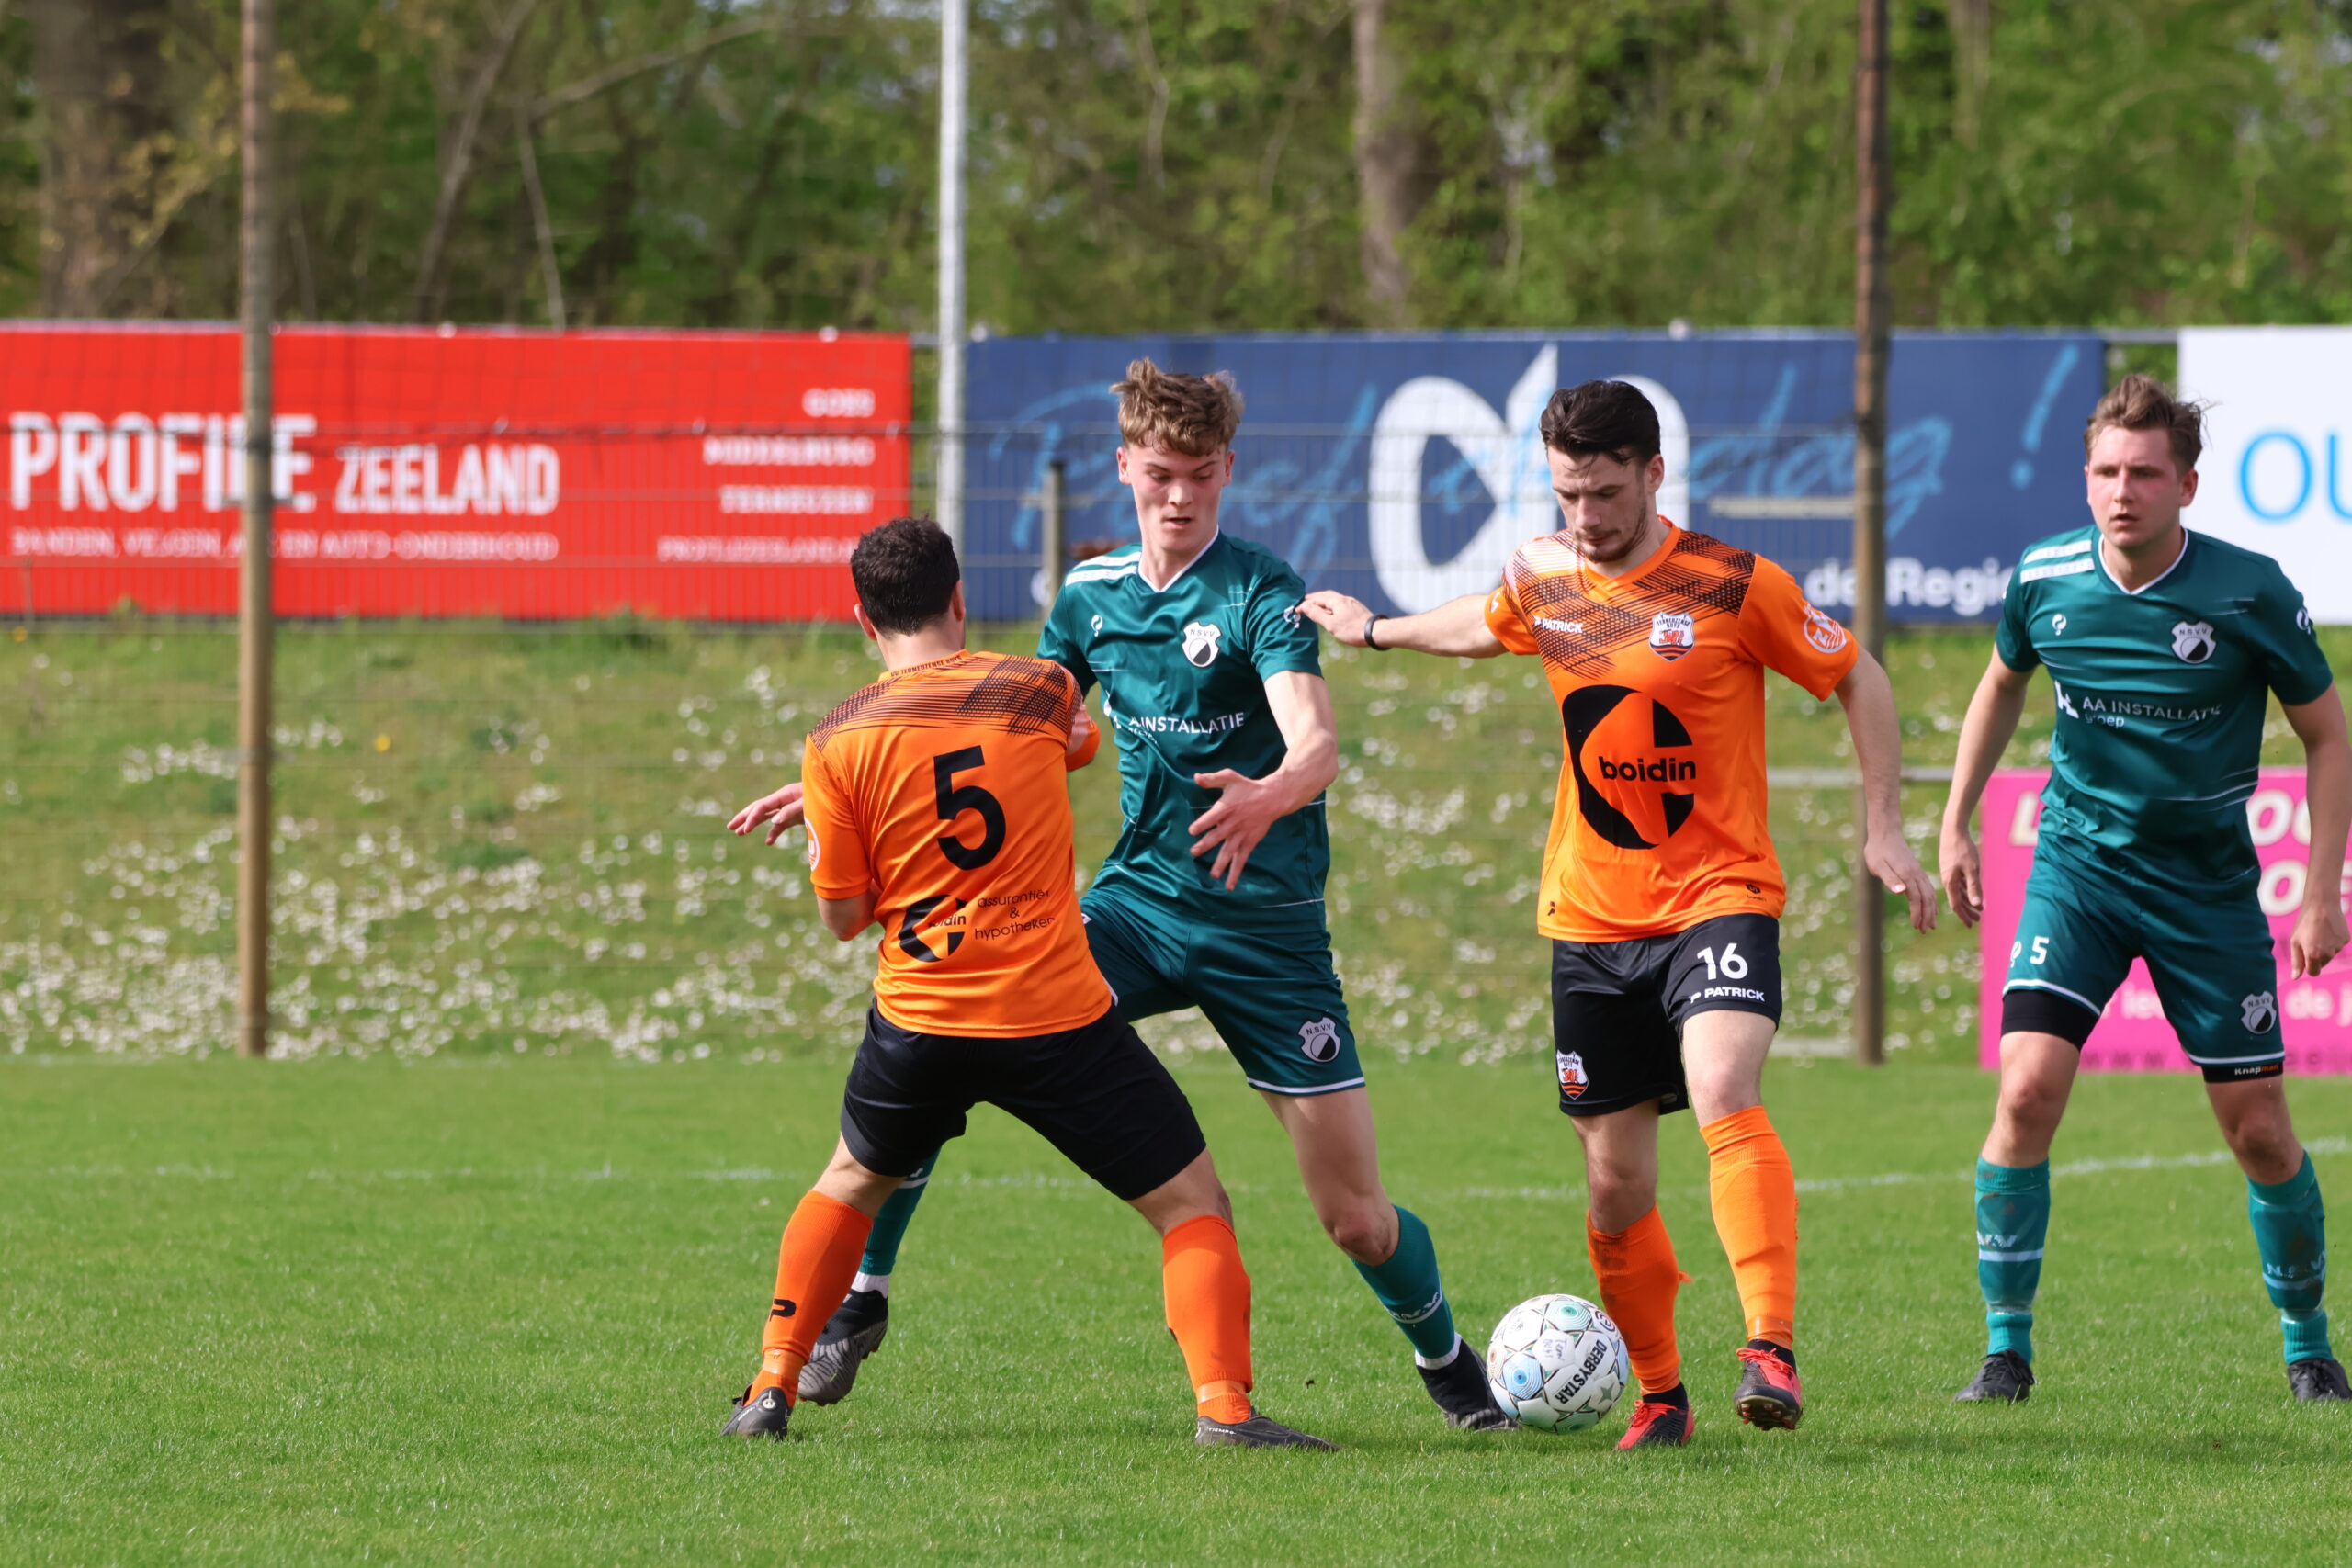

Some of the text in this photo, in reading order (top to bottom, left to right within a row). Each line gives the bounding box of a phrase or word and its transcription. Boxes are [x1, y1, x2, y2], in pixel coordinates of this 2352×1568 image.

[334, 443, 560, 515] ZEELAND
[1543, 618, 1583, 633] PATRICK
[2083, 696, 2106, 712] AA
[1598, 756, 1697, 782] boidin
[933, 745, 1006, 871] 5
[1010, 907, 1020, 919] &
[1697, 942, 1748, 981] 16
[2030, 936, 2049, 964] 5
[1704, 986, 1766, 1002] PATRICK
[1555, 1339, 1608, 1404] DERBYSTAR
